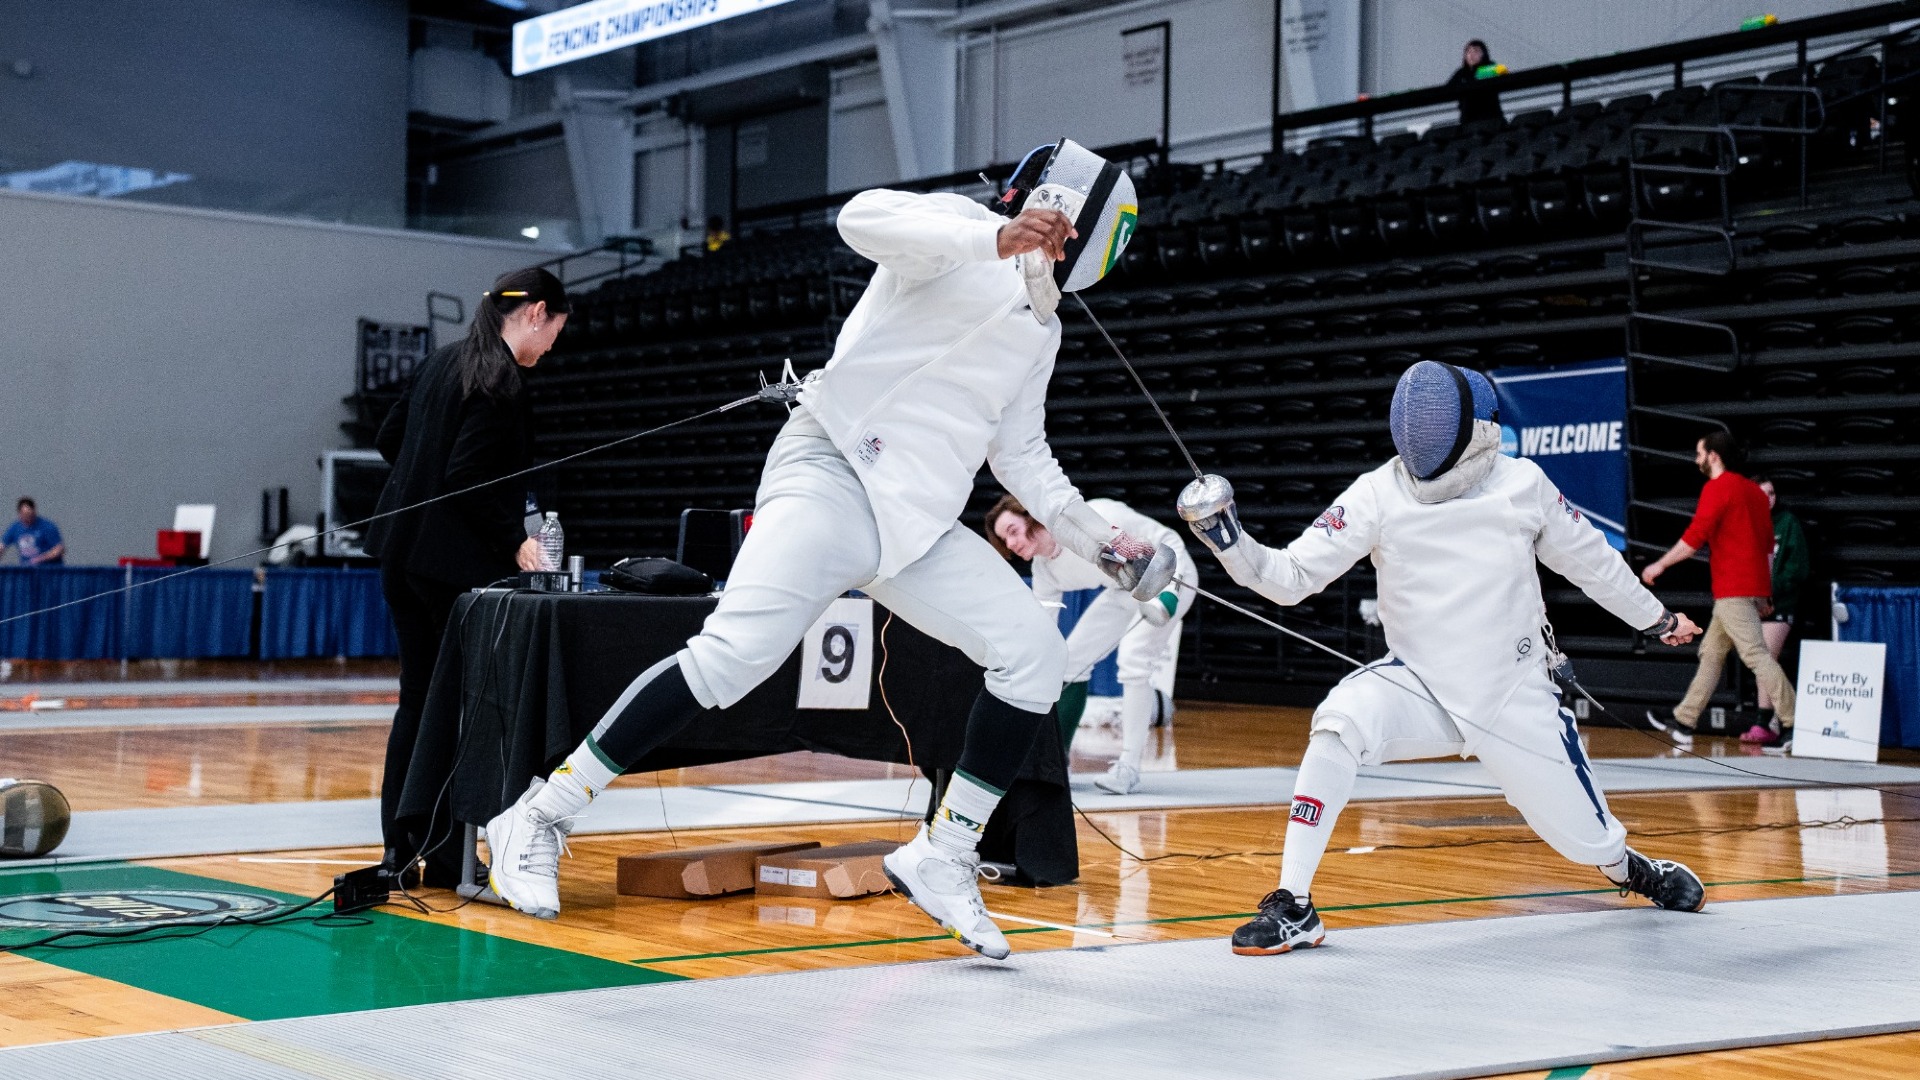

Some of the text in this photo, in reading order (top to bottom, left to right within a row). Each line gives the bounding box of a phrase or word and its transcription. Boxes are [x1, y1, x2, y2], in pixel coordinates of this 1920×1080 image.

[549, 20, 600, 56] FENCING
[605, 0, 718, 41] CHAMPIONSHIPS
[1520, 421, 1623, 457] WELCOME
[821, 625, 855, 684] 9
[1806, 683, 1874, 699] Credential
[1814, 670, 1868, 687] Entry By
[1825, 698, 1853, 713] Only
